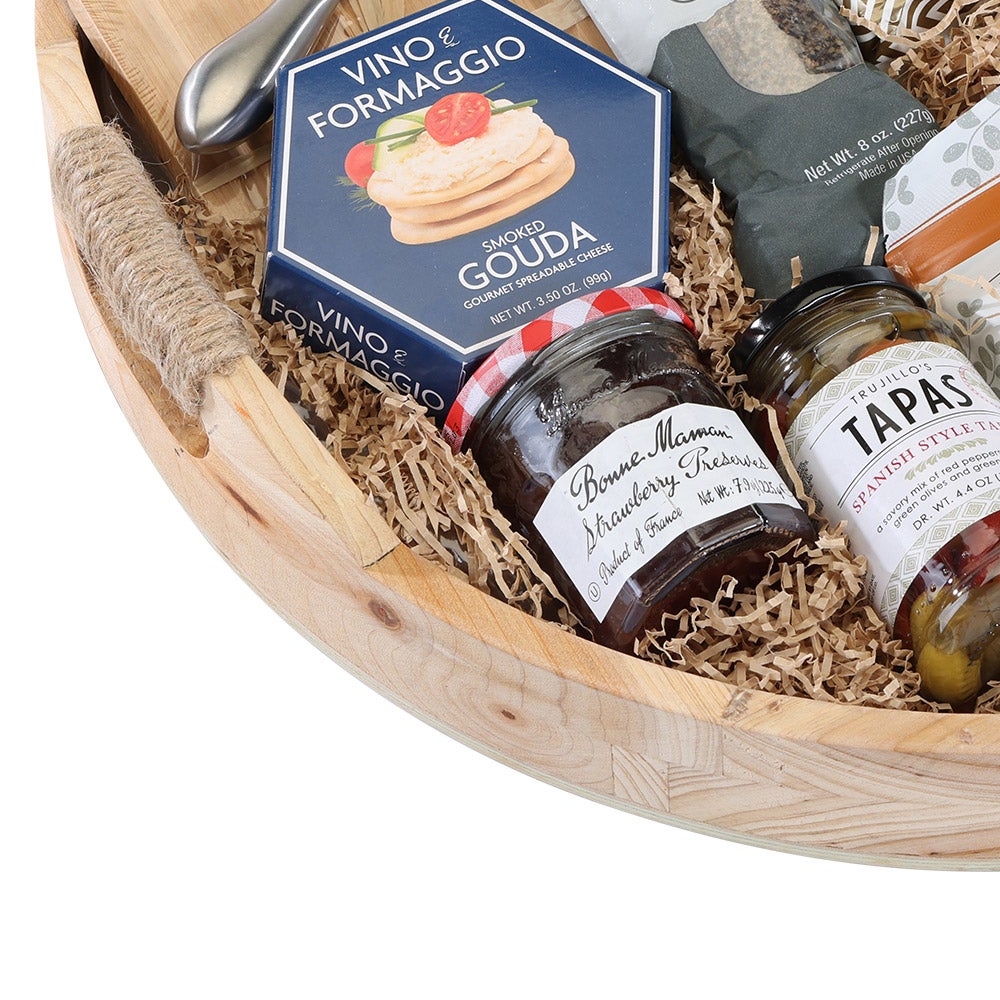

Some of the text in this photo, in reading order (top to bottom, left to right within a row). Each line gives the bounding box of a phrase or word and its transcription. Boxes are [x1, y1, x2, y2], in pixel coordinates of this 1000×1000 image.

[307, 35, 528, 139] FORMAGGIO
[340, 34, 435, 86] VINO
[804, 108, 936, 183] Net Wt. 8 oz. (227g)
[824, 142, 900, 187] Refrigerate After
[859, 164, 887, 182] Made
[888, 159, 898, 170] in
[457, 220, 598, 291] GOUDA
[481, 219, 547, 255] SMOKED
[463, 241, 615, 311] GOURMET SPREADABLE CHEESE
[488, 267, 613, 327] NET WT. 3.50 OZ. (99g)
[270, 298, 446, 412] FORMAGGIO
[315, 301, 390, 355] VINO
[840, 374, 974, 457] TAPAS
[850, 362, 932, 405] TRUJILLO'S
[570, 415, 734, 511] Bonne Maman
[851, 447, 916, 514] SPANISH
[918, 421, 974, 453] STYLE
[882, 493, 911, 527] savory
[910, 481, 929, 497] mix
[928, 468, 944, 484] of
[941, 459, 960, 476] red
[581, 446, 769, 562] Strawberry Preserves
[697, 489, 716, 506] Net
[893, 500, 921, 529] green
[920, 481, 949, 502] olives
[950, 467, 971, 483] and
[912, 513, 934, 532] DR.
[932, 498, 955, 517] WT.
[955, 483, 975, 499] 4.4
[975, 475, 994, 489] OZ
[598, 506, 684, 587] Product of France
